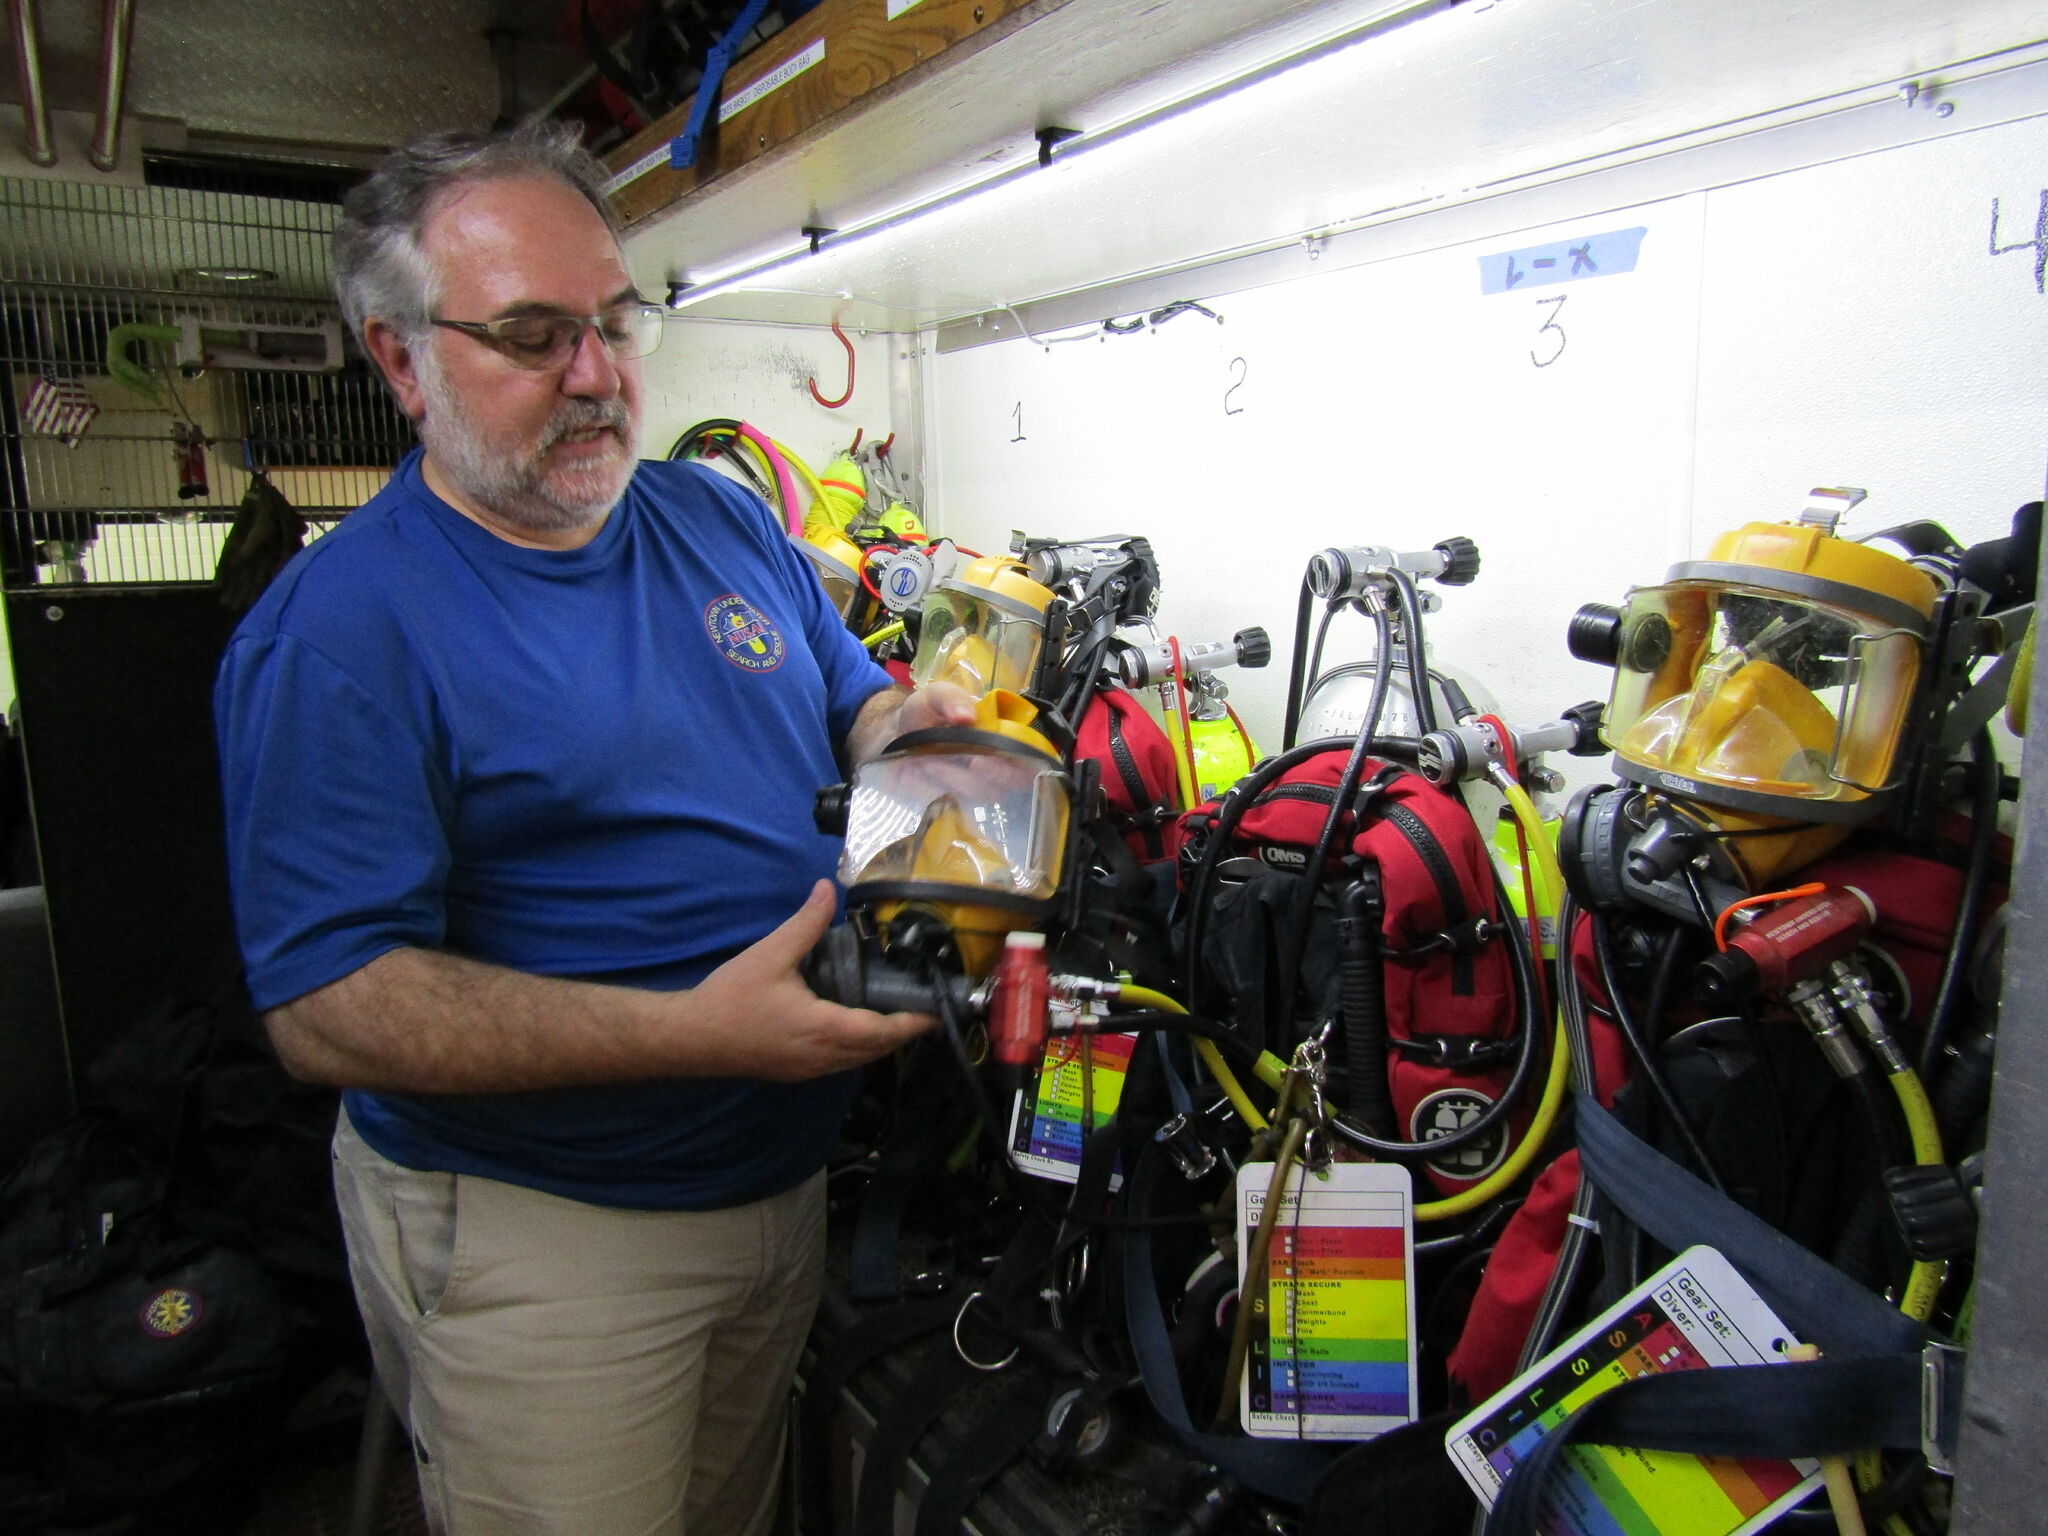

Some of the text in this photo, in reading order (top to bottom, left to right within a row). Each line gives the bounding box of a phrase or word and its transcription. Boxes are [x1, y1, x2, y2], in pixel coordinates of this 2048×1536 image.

[798, 53, 810, 69] BAG
[1989, 188, 2048, 294] 4
[1531, 294, 1568, 369] 3
[1224, 356, 1247, 416] 2
[1010, 400, 1027, 442] 1
[708, 606, 725, 644] NEWTOWN
[726, 648, 760, 668] SEARCH
[762, 656, 777, 668] AND
[1266, 847, 1306, 864] OMS
[1678, 1278, 1708, 1310] Gear
[1253, 1299, 1265, 1313] S
[1659, 1289, 1696, 1332] Diver:
[1296, 1318, 1327, 1326] Weights
[1632, 1312, 1653, 1330] A
[1254, 1340, 1264, 1355] L
[1608, 1329, 1627, 1348] S
[1272, 1361, 1315, 1369] INFLTOR
[1571, 1358, 1590, 1376] S
[1529, 1387, 1544, 1408] L
[1251, 1413, 1273, 1421] Safety
[1480, 1428, 1497, 1447] C
[1463, 1435, 1502, 1488] Safety Chec
